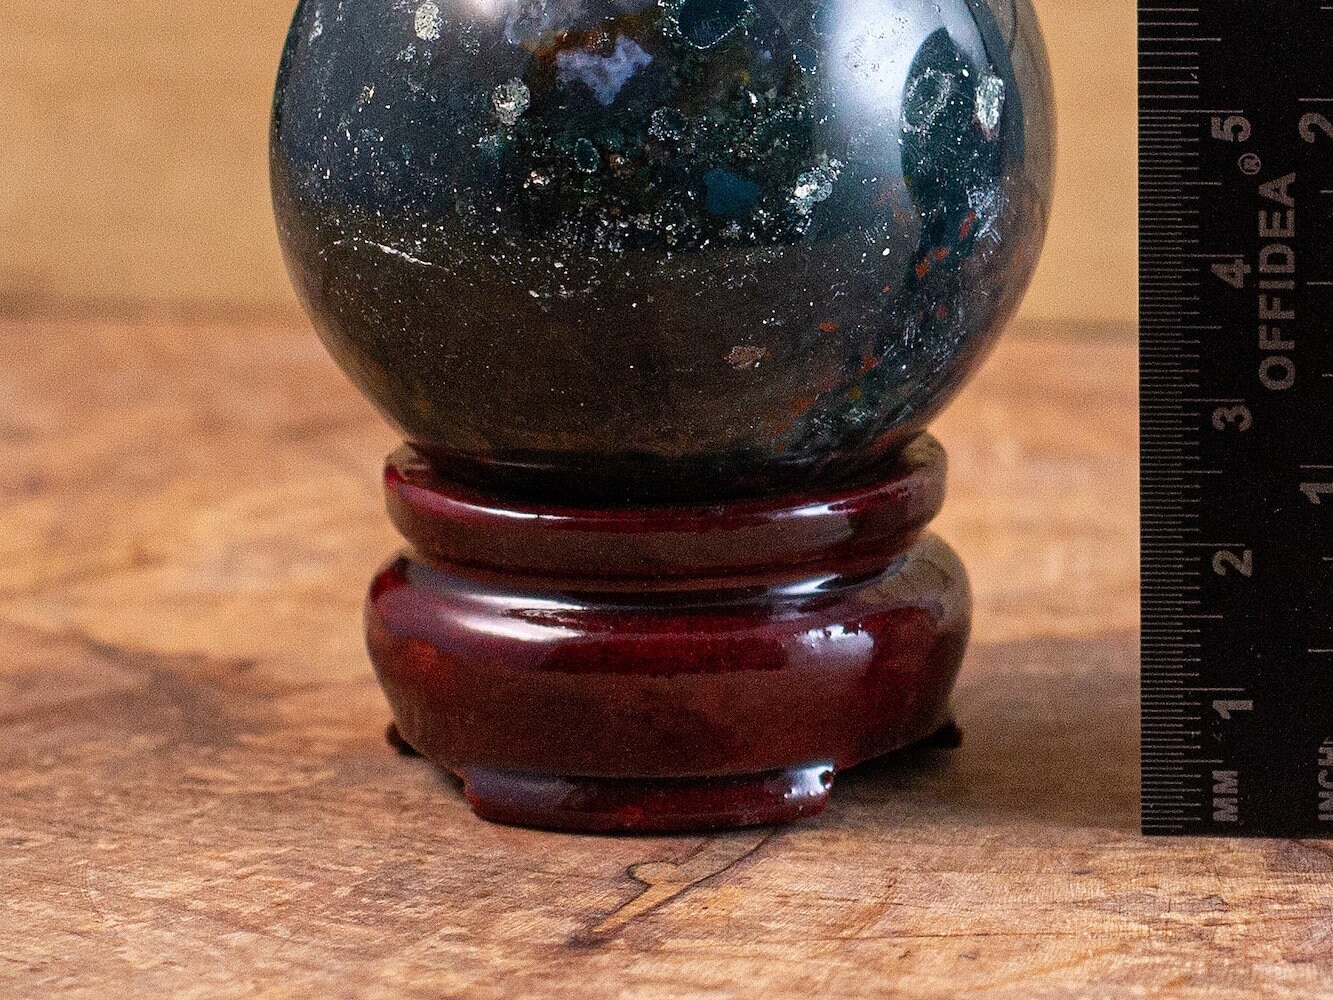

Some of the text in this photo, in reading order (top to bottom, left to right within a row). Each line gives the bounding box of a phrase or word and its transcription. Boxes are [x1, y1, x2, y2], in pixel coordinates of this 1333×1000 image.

[1211, 115, 1251, 142] 5
[1211, 258, 1251, 288] 4
[1211, 405, 1252, 432] 3
[1212, 550, 1252, 577] 2
[1212, 699, 1253, 719] 1
[1212, 770, 1238, 822] MM
